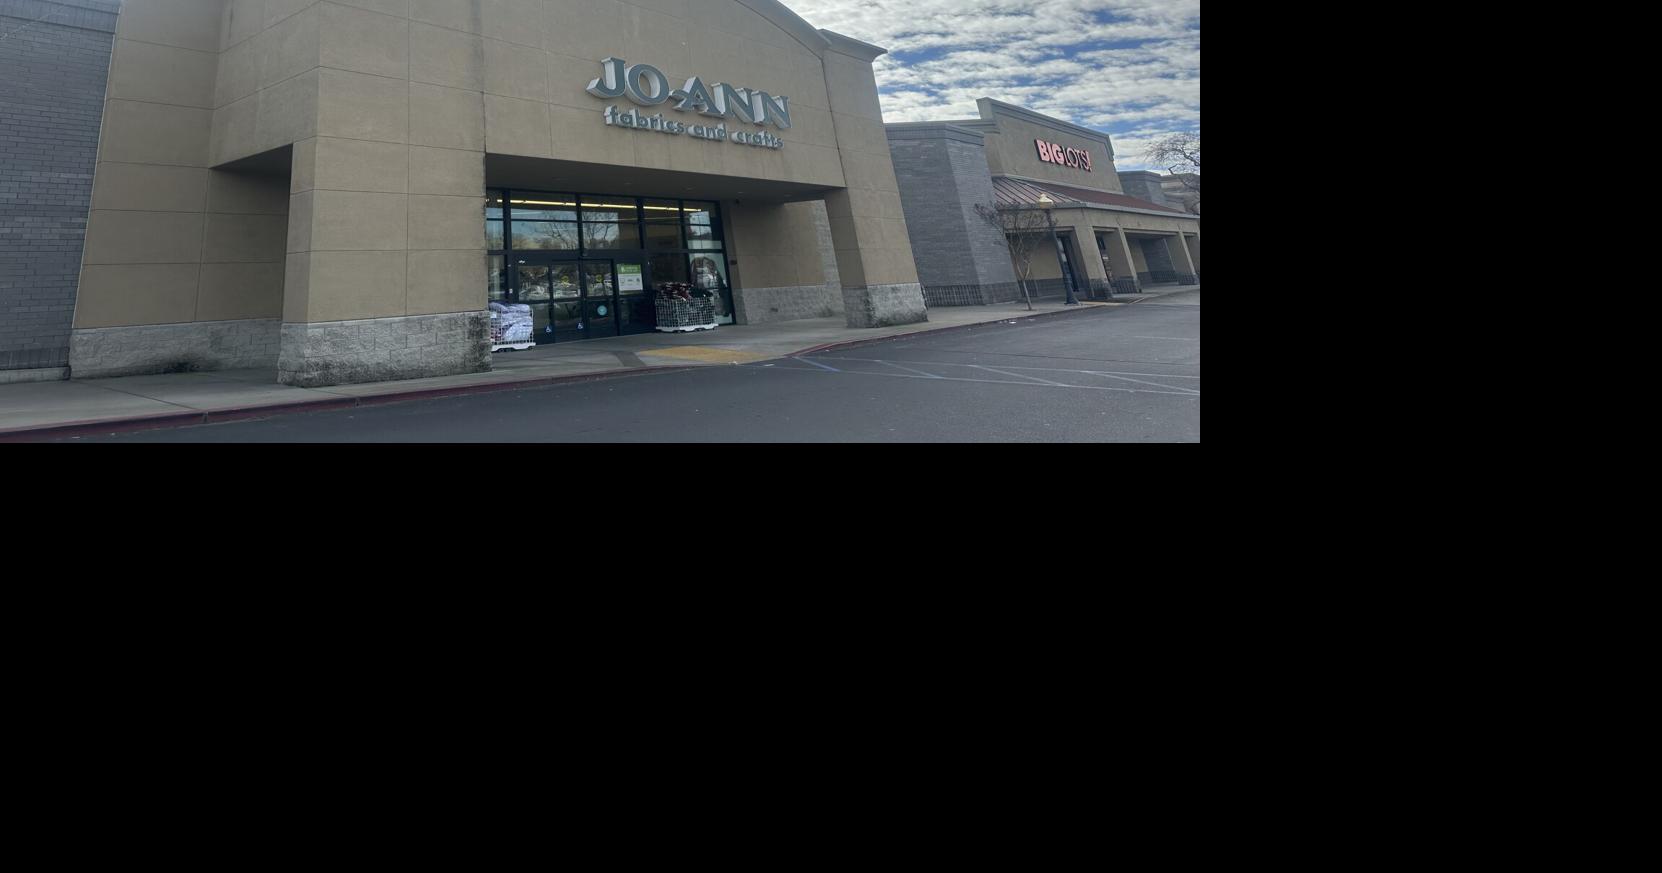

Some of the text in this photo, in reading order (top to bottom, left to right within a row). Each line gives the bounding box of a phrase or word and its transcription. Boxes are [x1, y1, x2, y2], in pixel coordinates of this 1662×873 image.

[586, 57, 792, 129] JO-ANN
[604, 105, 784, 149] fabrics and crafts
[1035, 139, 1092, 172] BIG LOTS!
